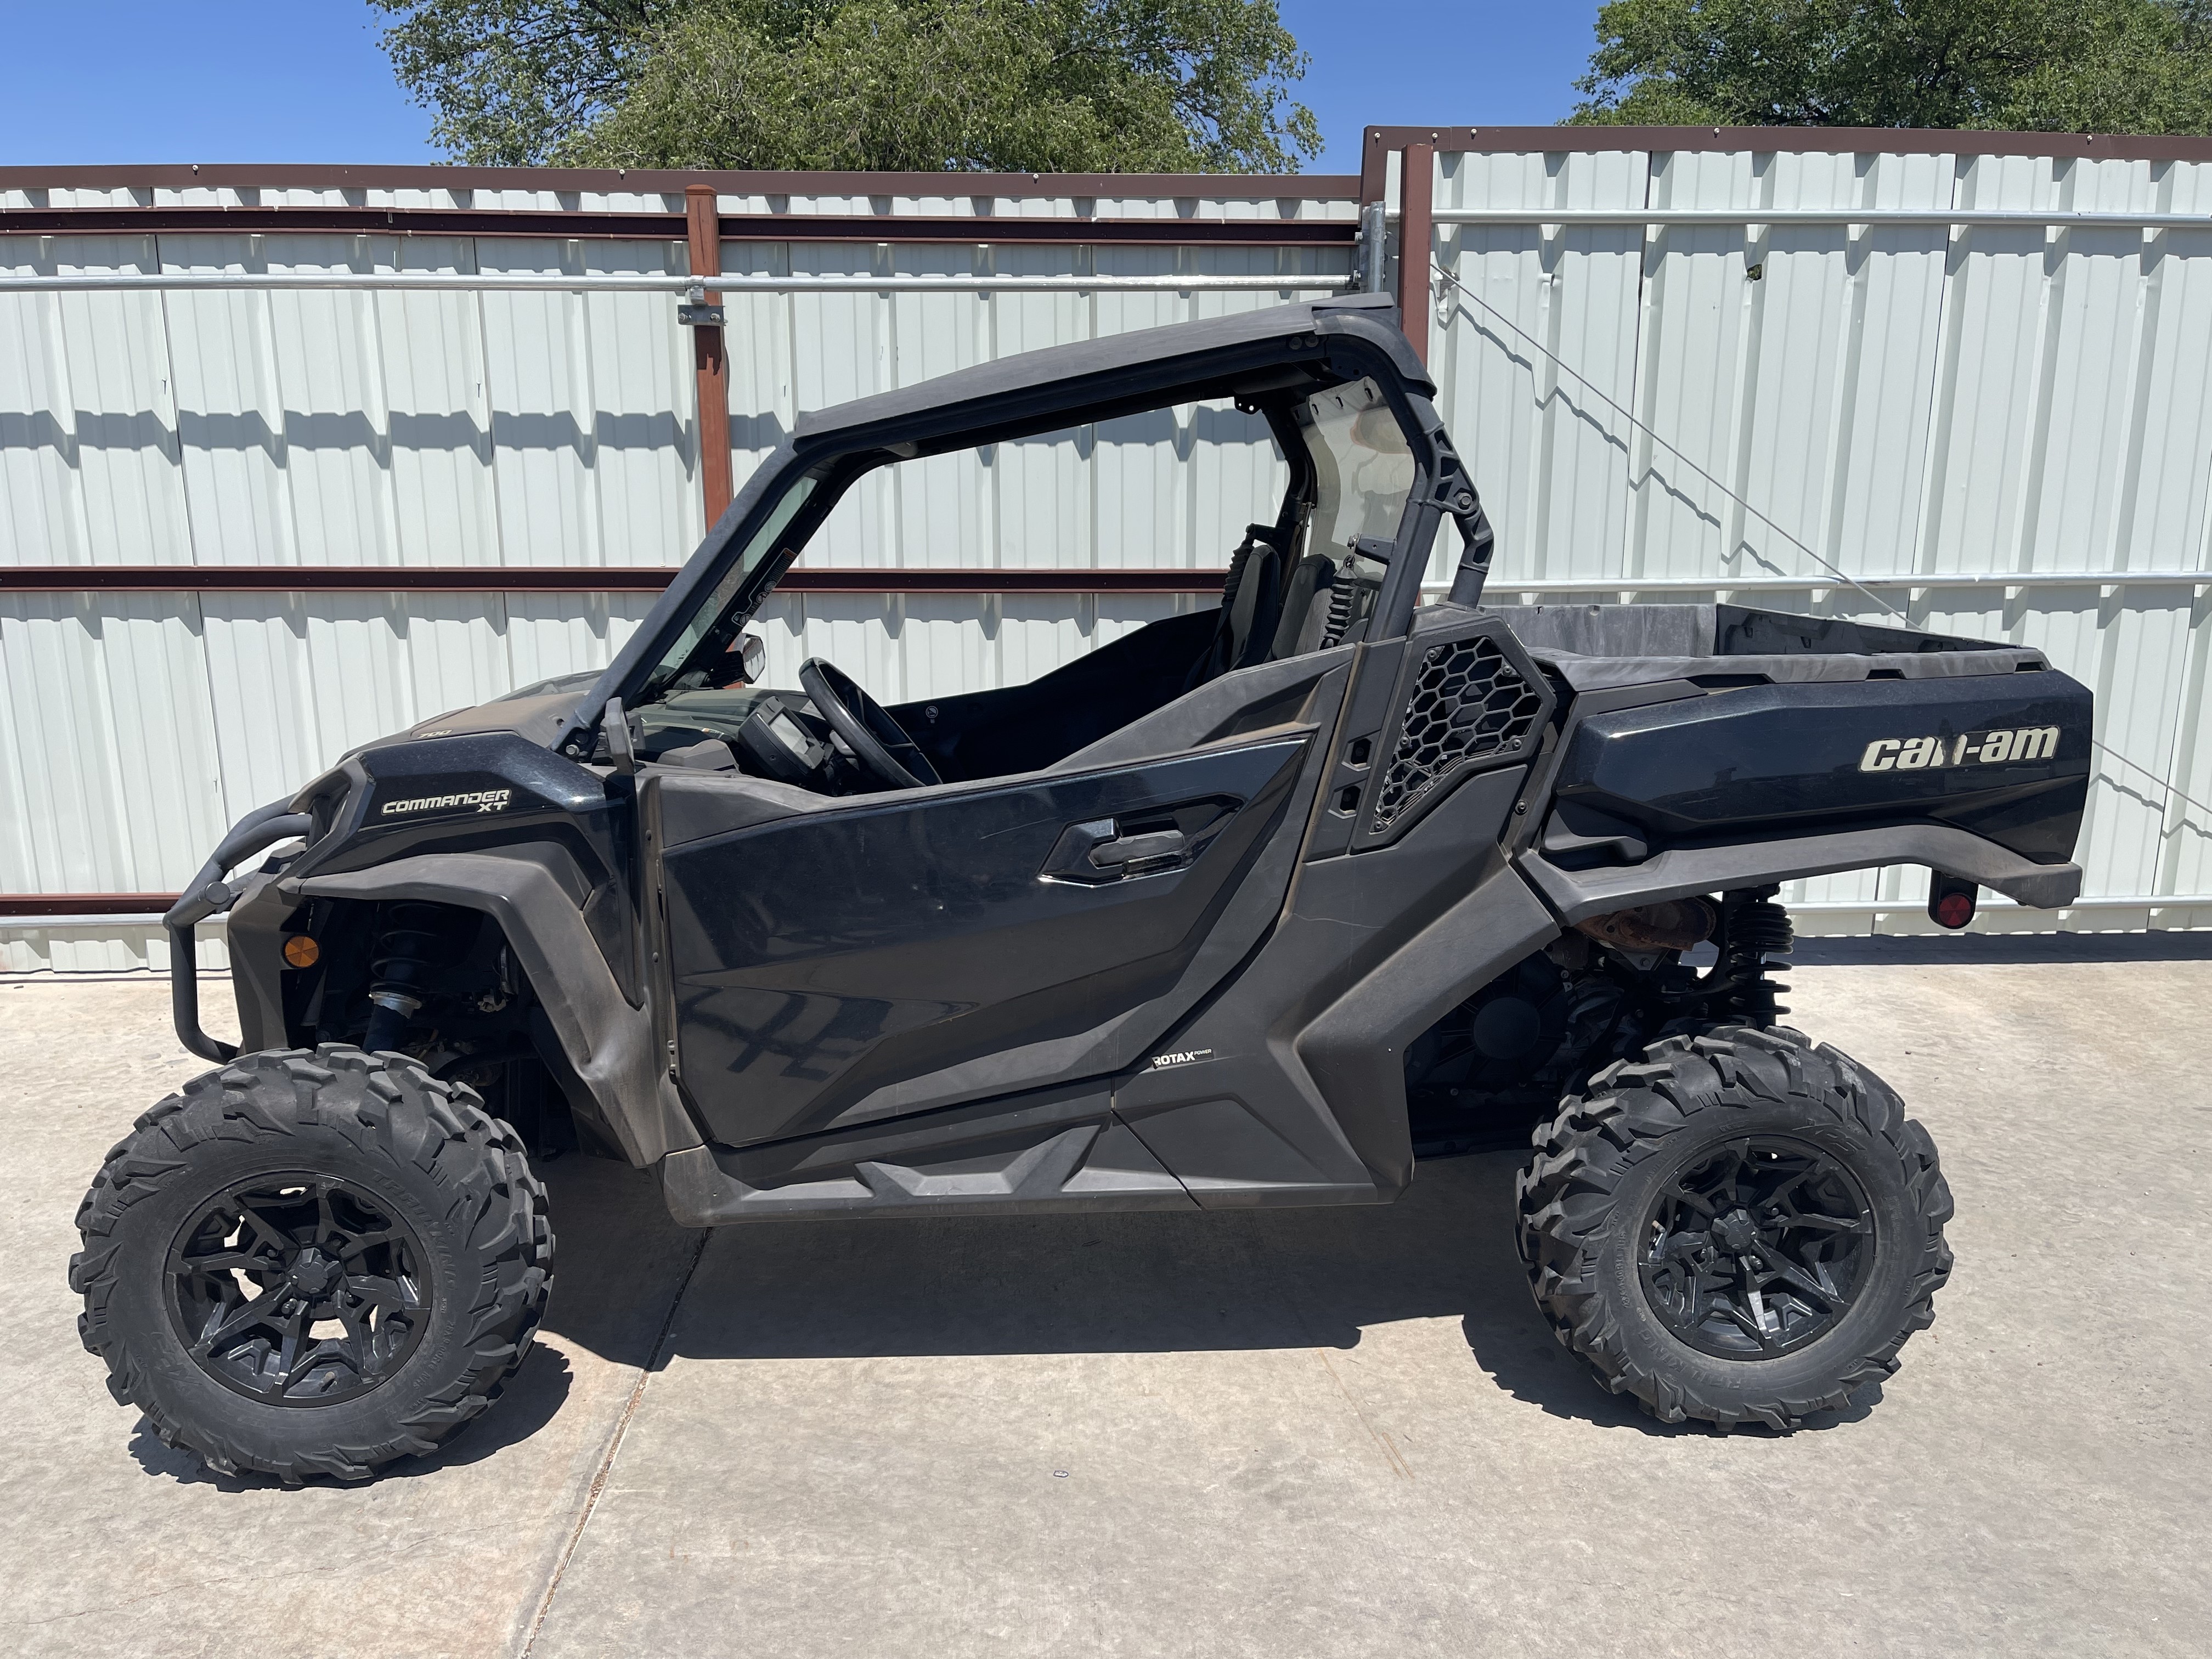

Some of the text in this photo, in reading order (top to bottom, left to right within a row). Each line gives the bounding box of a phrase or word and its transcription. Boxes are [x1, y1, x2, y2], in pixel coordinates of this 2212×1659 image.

[417, 729, 453, 739] 700
[382, 789, 510, 814] COMMANDER
[477, 800, 508, 813] XT
[1152, 1051, 1196, 1068] ROTAX
